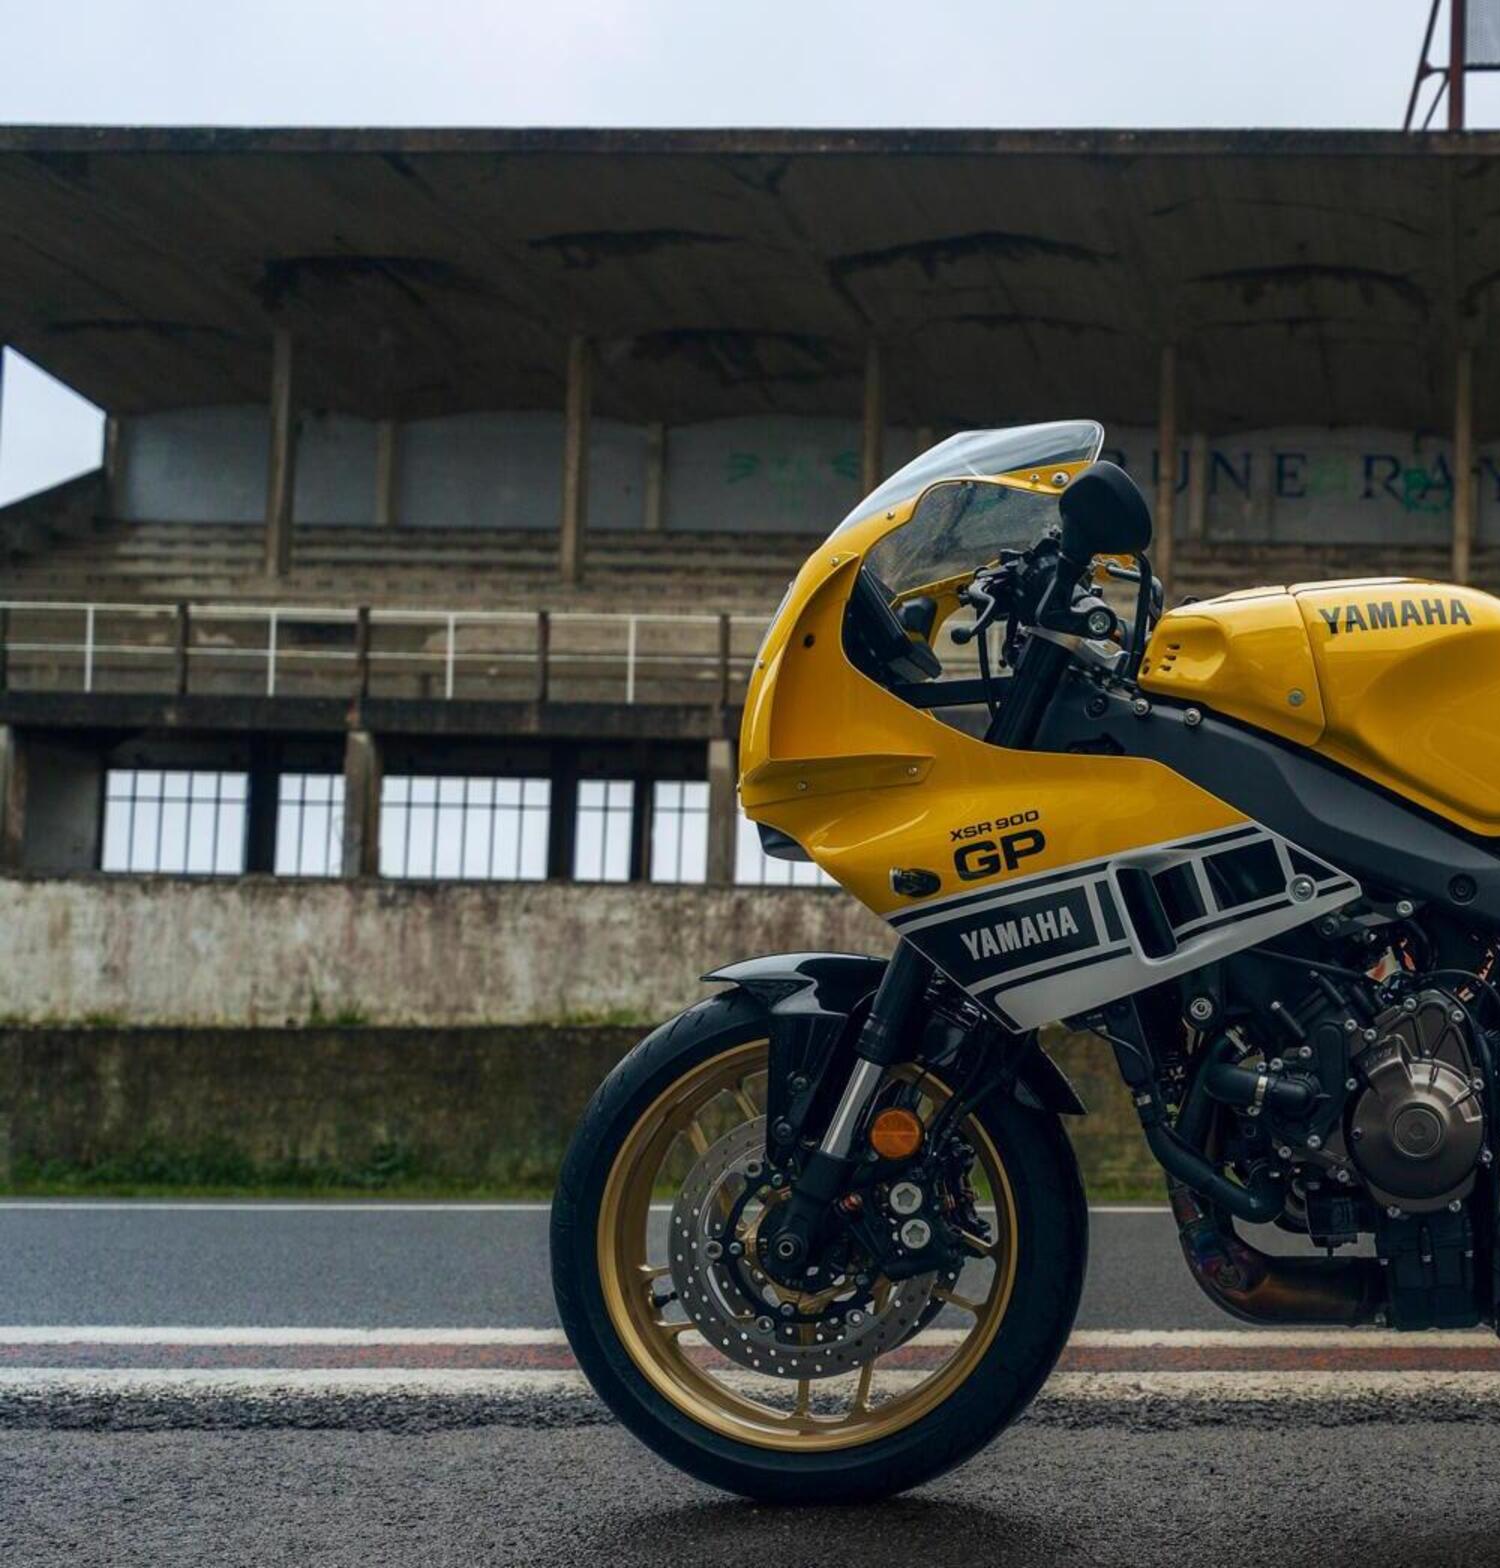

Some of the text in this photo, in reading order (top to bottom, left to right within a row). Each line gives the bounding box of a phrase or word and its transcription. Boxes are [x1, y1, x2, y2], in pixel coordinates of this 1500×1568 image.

[1109, 449, 1308, 499] UNE
[1319, 599, 1472, 634] YAMAHA
[951, 810, 1040, 842] XSR 900
[954, 829, 1046, 881] GP
[960, 906, 1079, 961] YAMAHA
